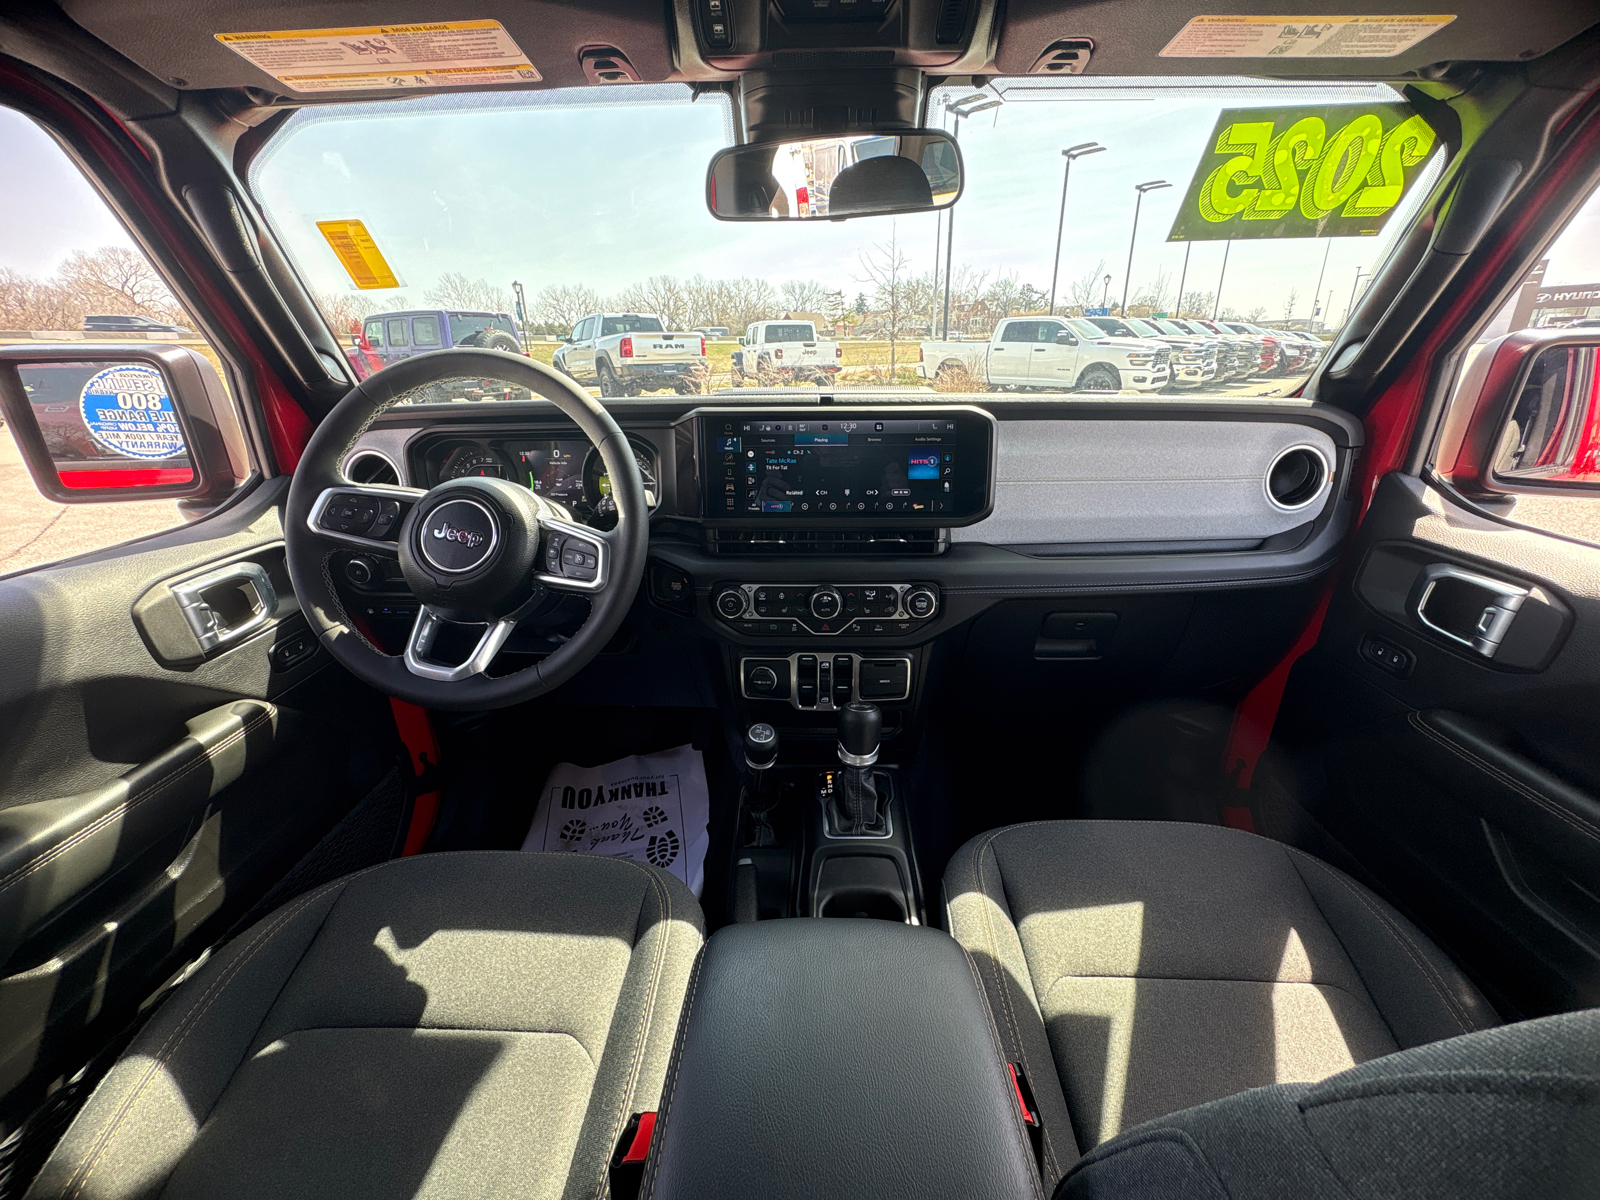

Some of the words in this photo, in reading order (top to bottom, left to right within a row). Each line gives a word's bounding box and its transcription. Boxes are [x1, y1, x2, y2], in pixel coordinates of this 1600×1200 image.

[391, 25, 413, 33] MISE
[802, 348, 818, 356] Jeep
[840, 422, 857, 430] 12:30
[553, 449, 560, 458] 0
[433, 521, 483, 549] Jeep
[561, 785, 606, 810] YOU
[608, 780, 669, 803] THANK
[590, 828, 645, 851] Thank
